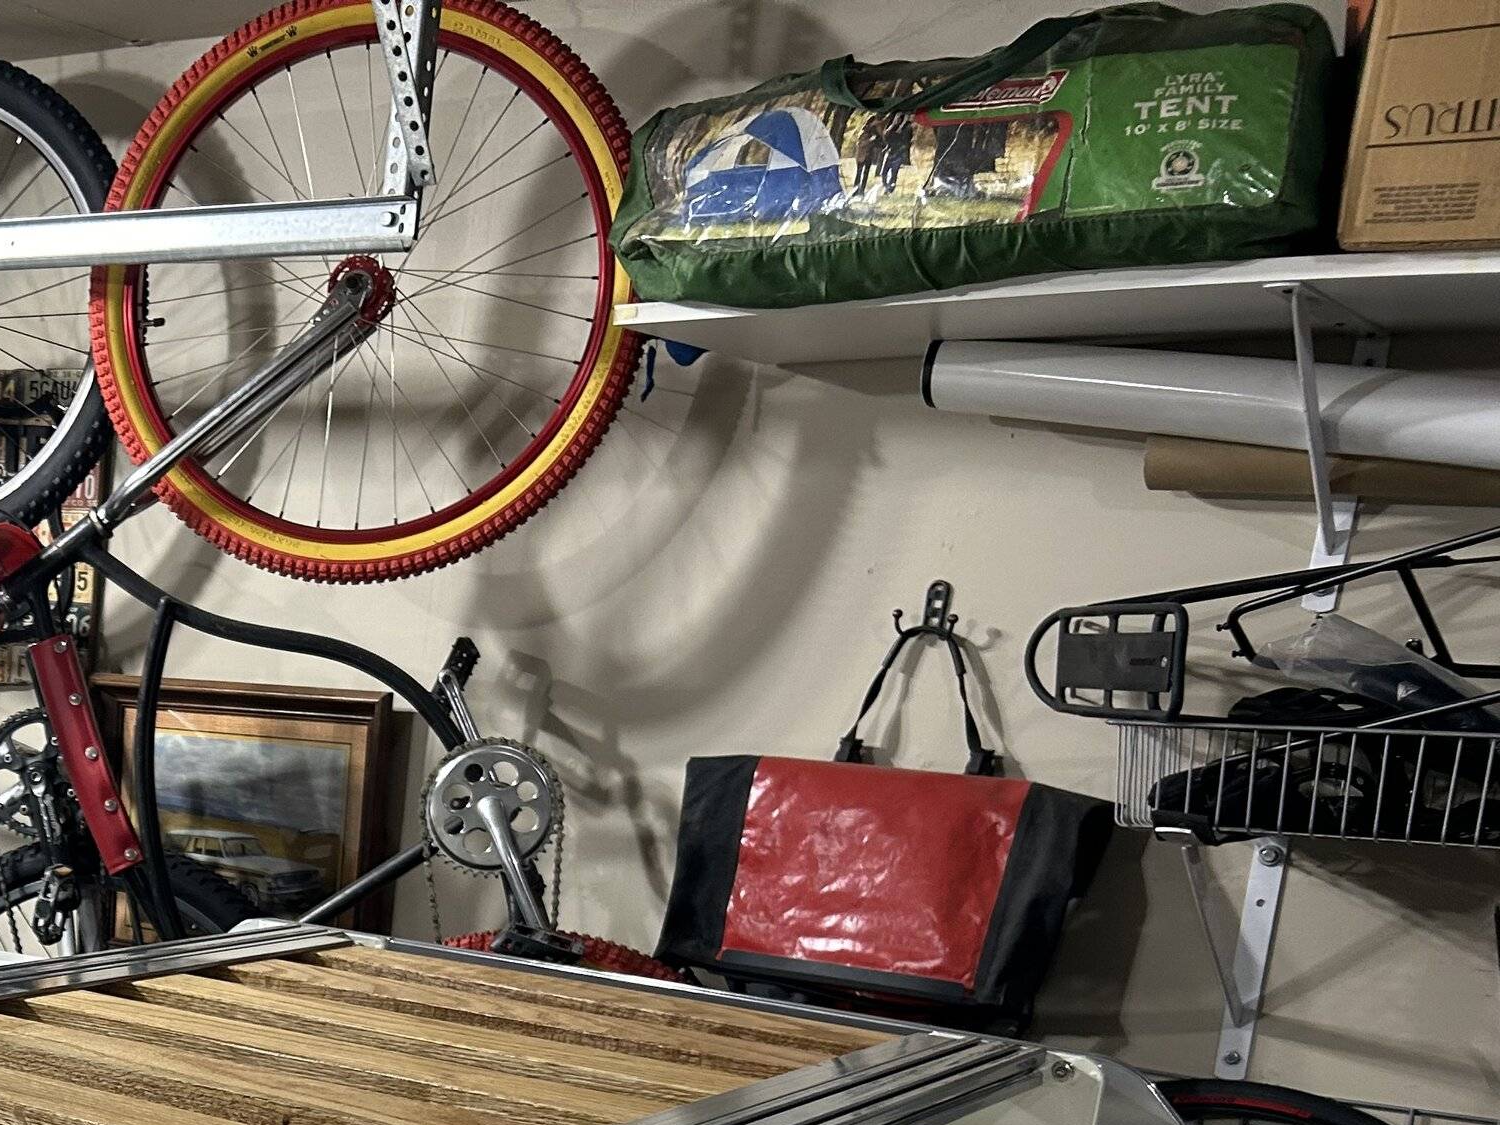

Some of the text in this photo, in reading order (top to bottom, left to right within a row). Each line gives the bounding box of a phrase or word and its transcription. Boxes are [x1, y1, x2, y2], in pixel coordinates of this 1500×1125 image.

[1164, 72, 1216, 87] LYRA
[1153, 83, 1227, 98] FAMILY
[1133, 95, 1239, 120] TENT
[1197, 118, 1243, 130] SIZE
[1384, 99, 1500, 140] ITRUS
